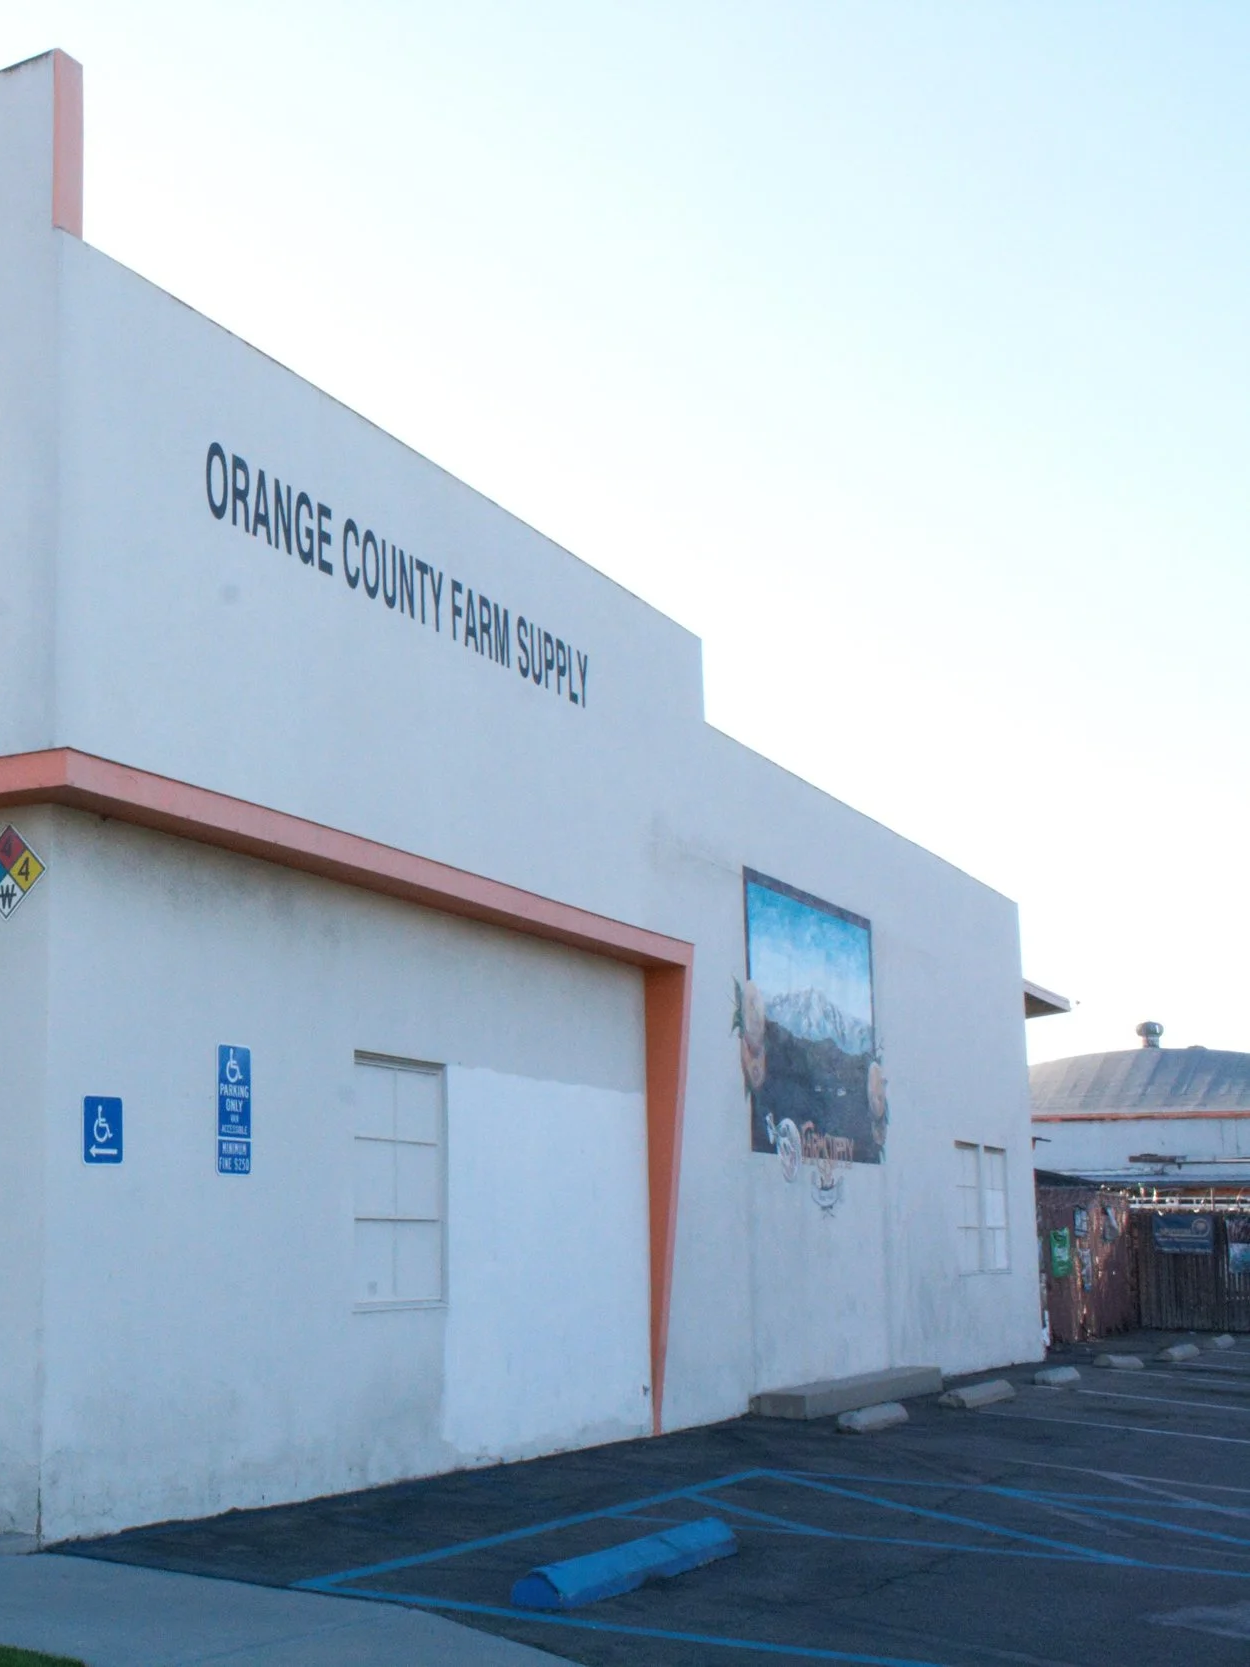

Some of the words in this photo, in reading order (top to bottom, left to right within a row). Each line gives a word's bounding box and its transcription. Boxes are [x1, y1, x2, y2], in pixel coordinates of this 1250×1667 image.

[205, 441, 334, 577] ORANGE
[342, 517, 444, 633] COUNTY
[450, 577, 511, 670] FARM
[516, 614, 589, 709] SUPPLY
[1, 835, 14, 858] 4
[17, 856, 30, 882] 4
[220, 1083, 249, 1097] PARKING
[226, 1099, 243, 1112] ONLY
[219, 1157, 232, 1170] FINE
[234, 1158, 249, 1171] $250
